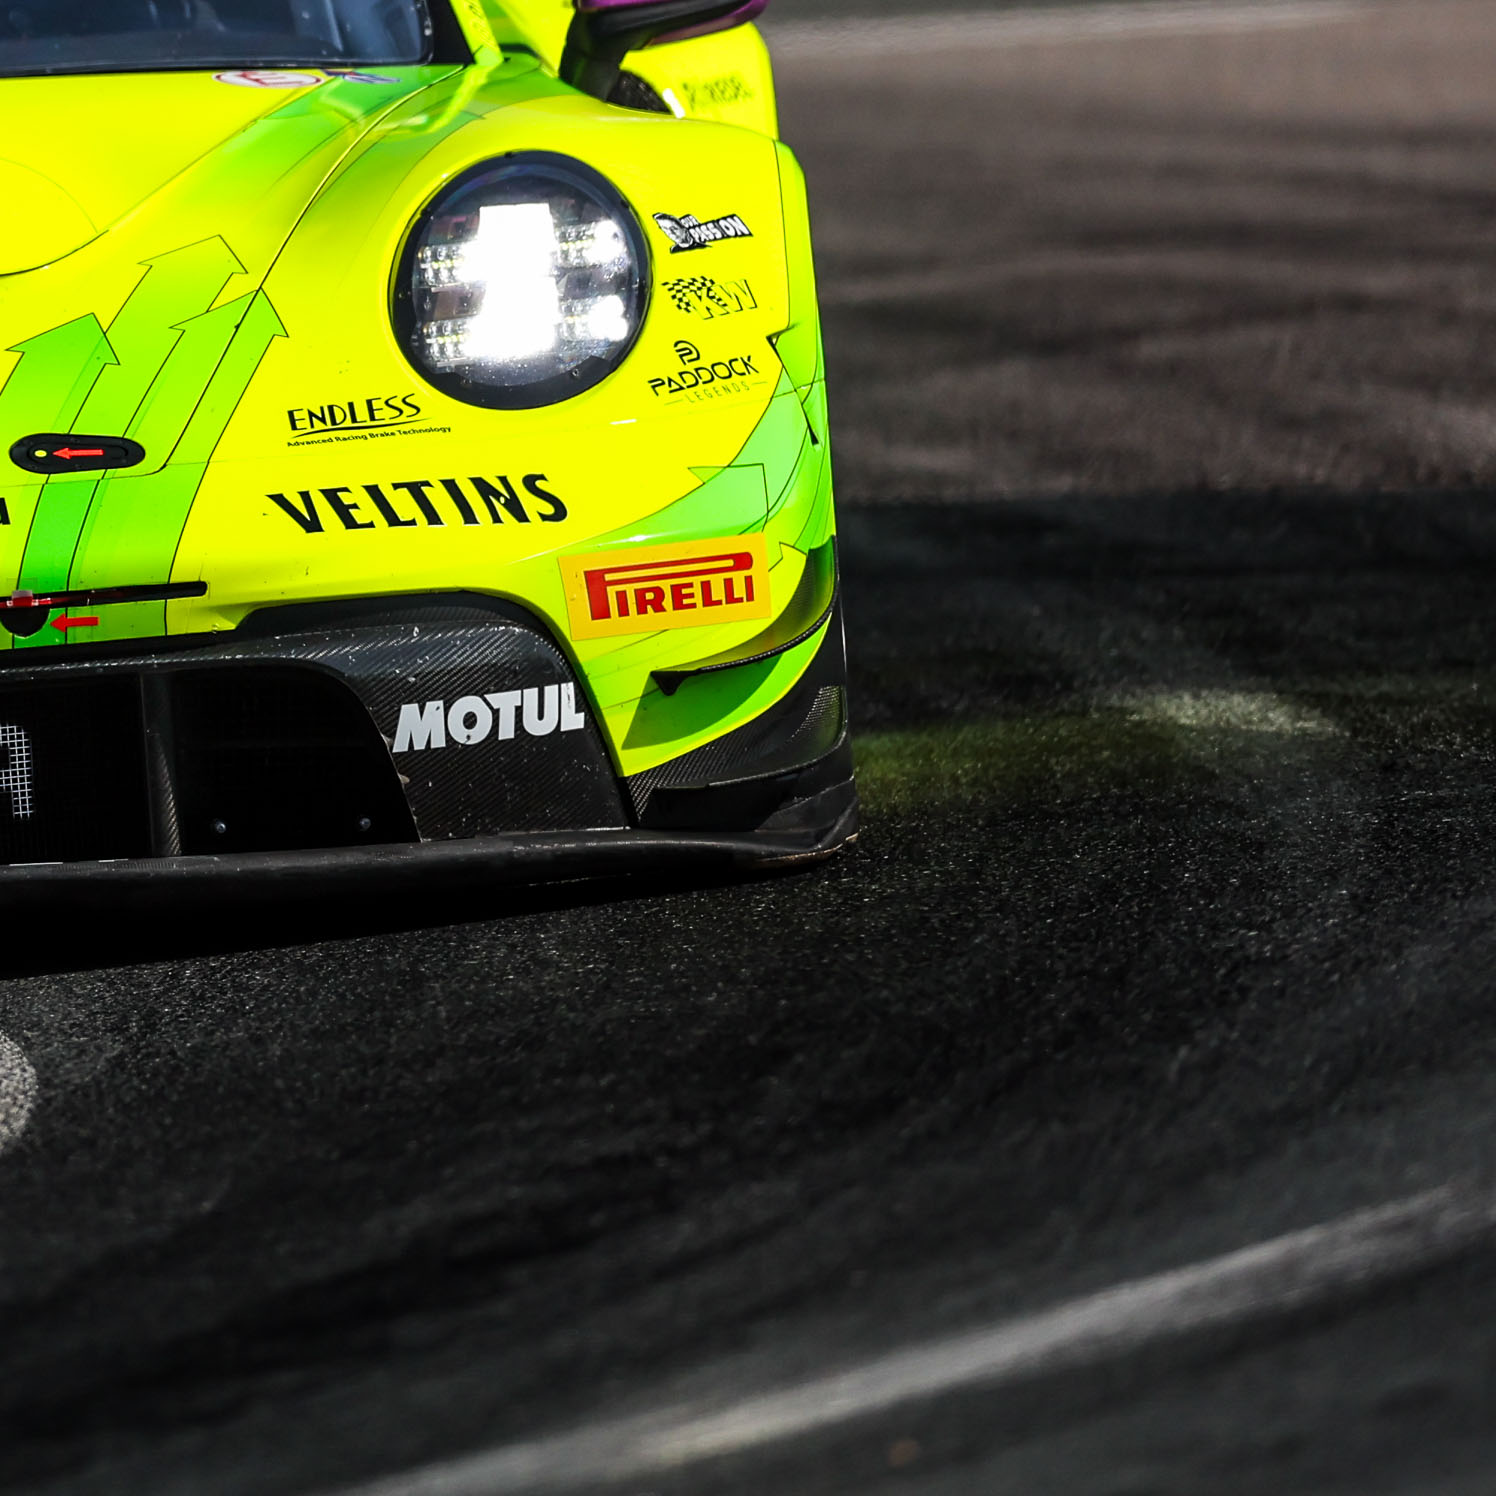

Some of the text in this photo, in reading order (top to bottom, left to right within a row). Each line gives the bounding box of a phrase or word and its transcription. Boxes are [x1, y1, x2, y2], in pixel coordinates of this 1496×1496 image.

[684, 279, 758, 321] KW
[648, 354, 760, 397] PADDOCK
[684, 380, 751, 404] LEGENDS
[287, 393, 421, 431] ENDLESS
[287, 426, 452, 447] Advanced Racing Brake Technology
[263, 473, 569, 534] VELTINS
[583, 551, 756, 621] PIRELLI
[392, 682, 586, 754] MOTUL
